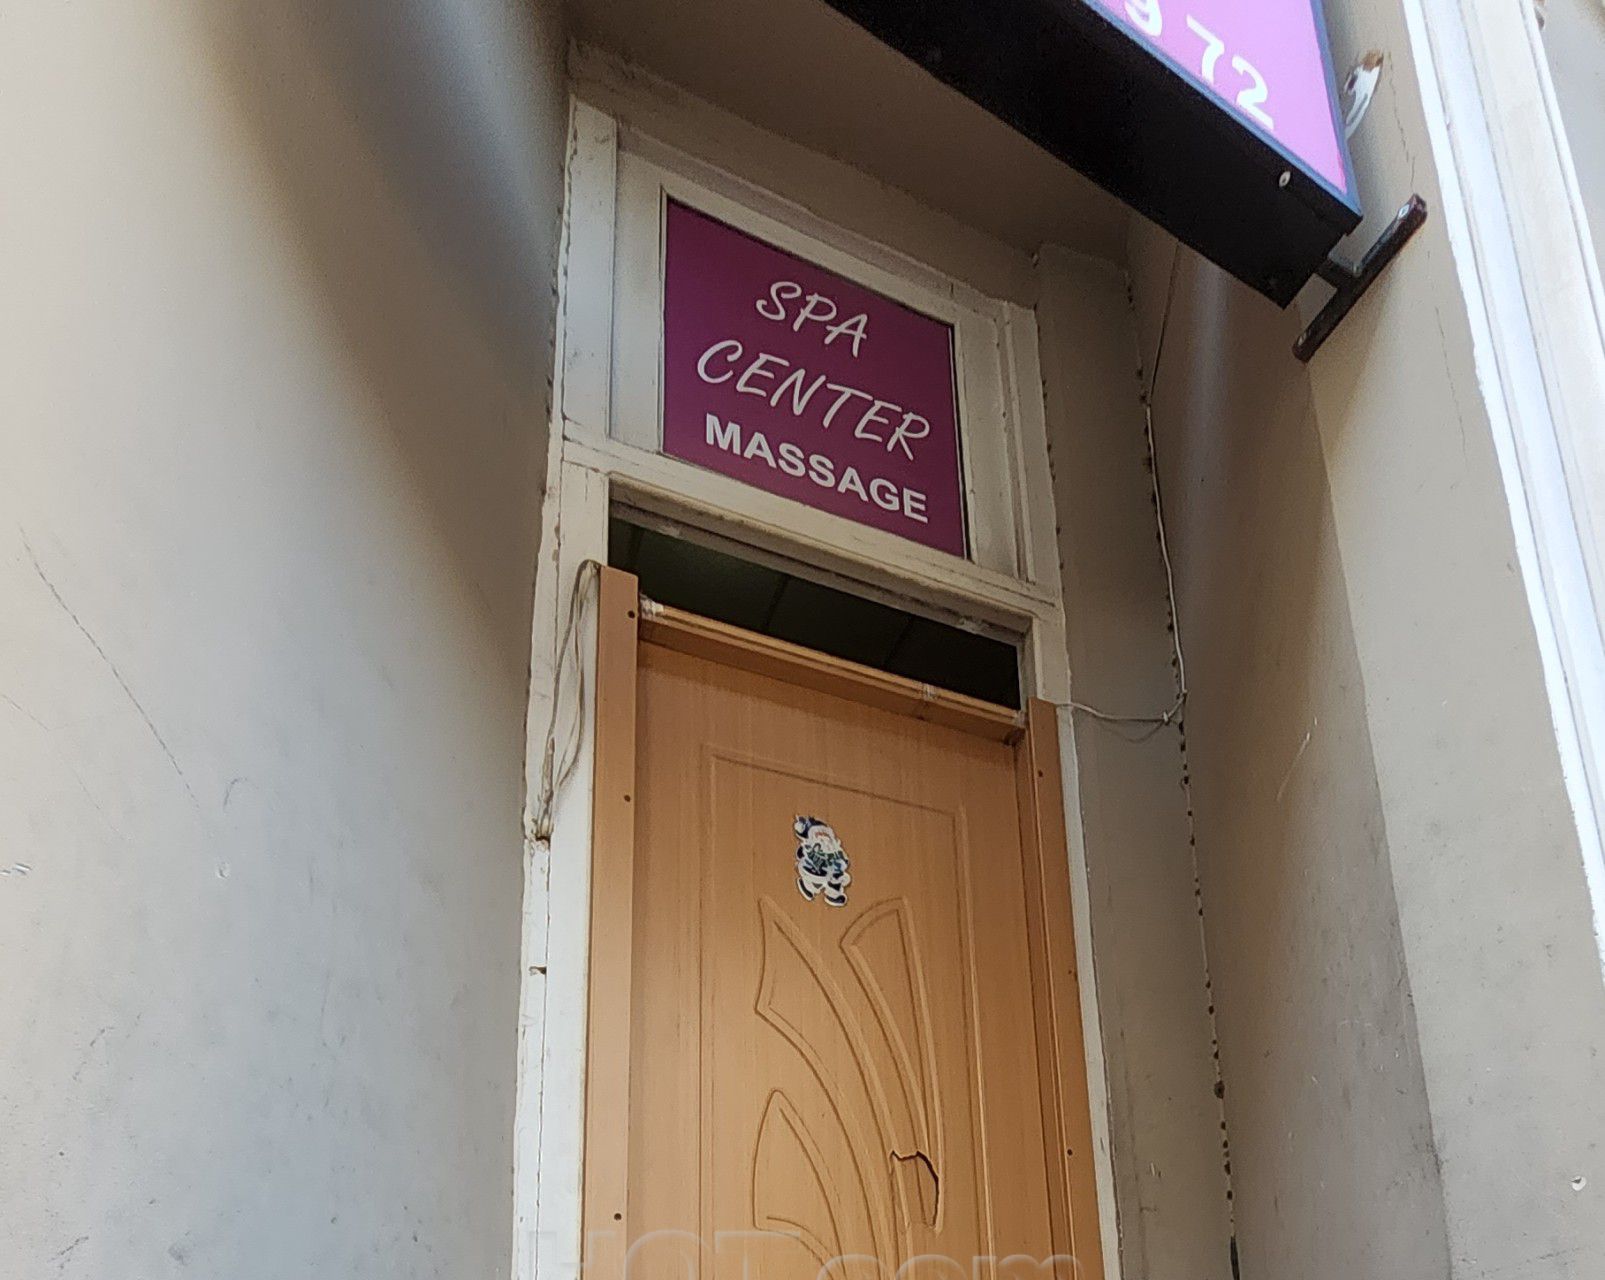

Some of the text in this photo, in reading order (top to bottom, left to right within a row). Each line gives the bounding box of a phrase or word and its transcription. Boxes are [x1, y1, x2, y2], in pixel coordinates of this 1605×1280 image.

[755, 280, 869, 358] SPA
[696, 339, 931, 461] CENTER
[705, 412, 929, 525] MASSAGE
